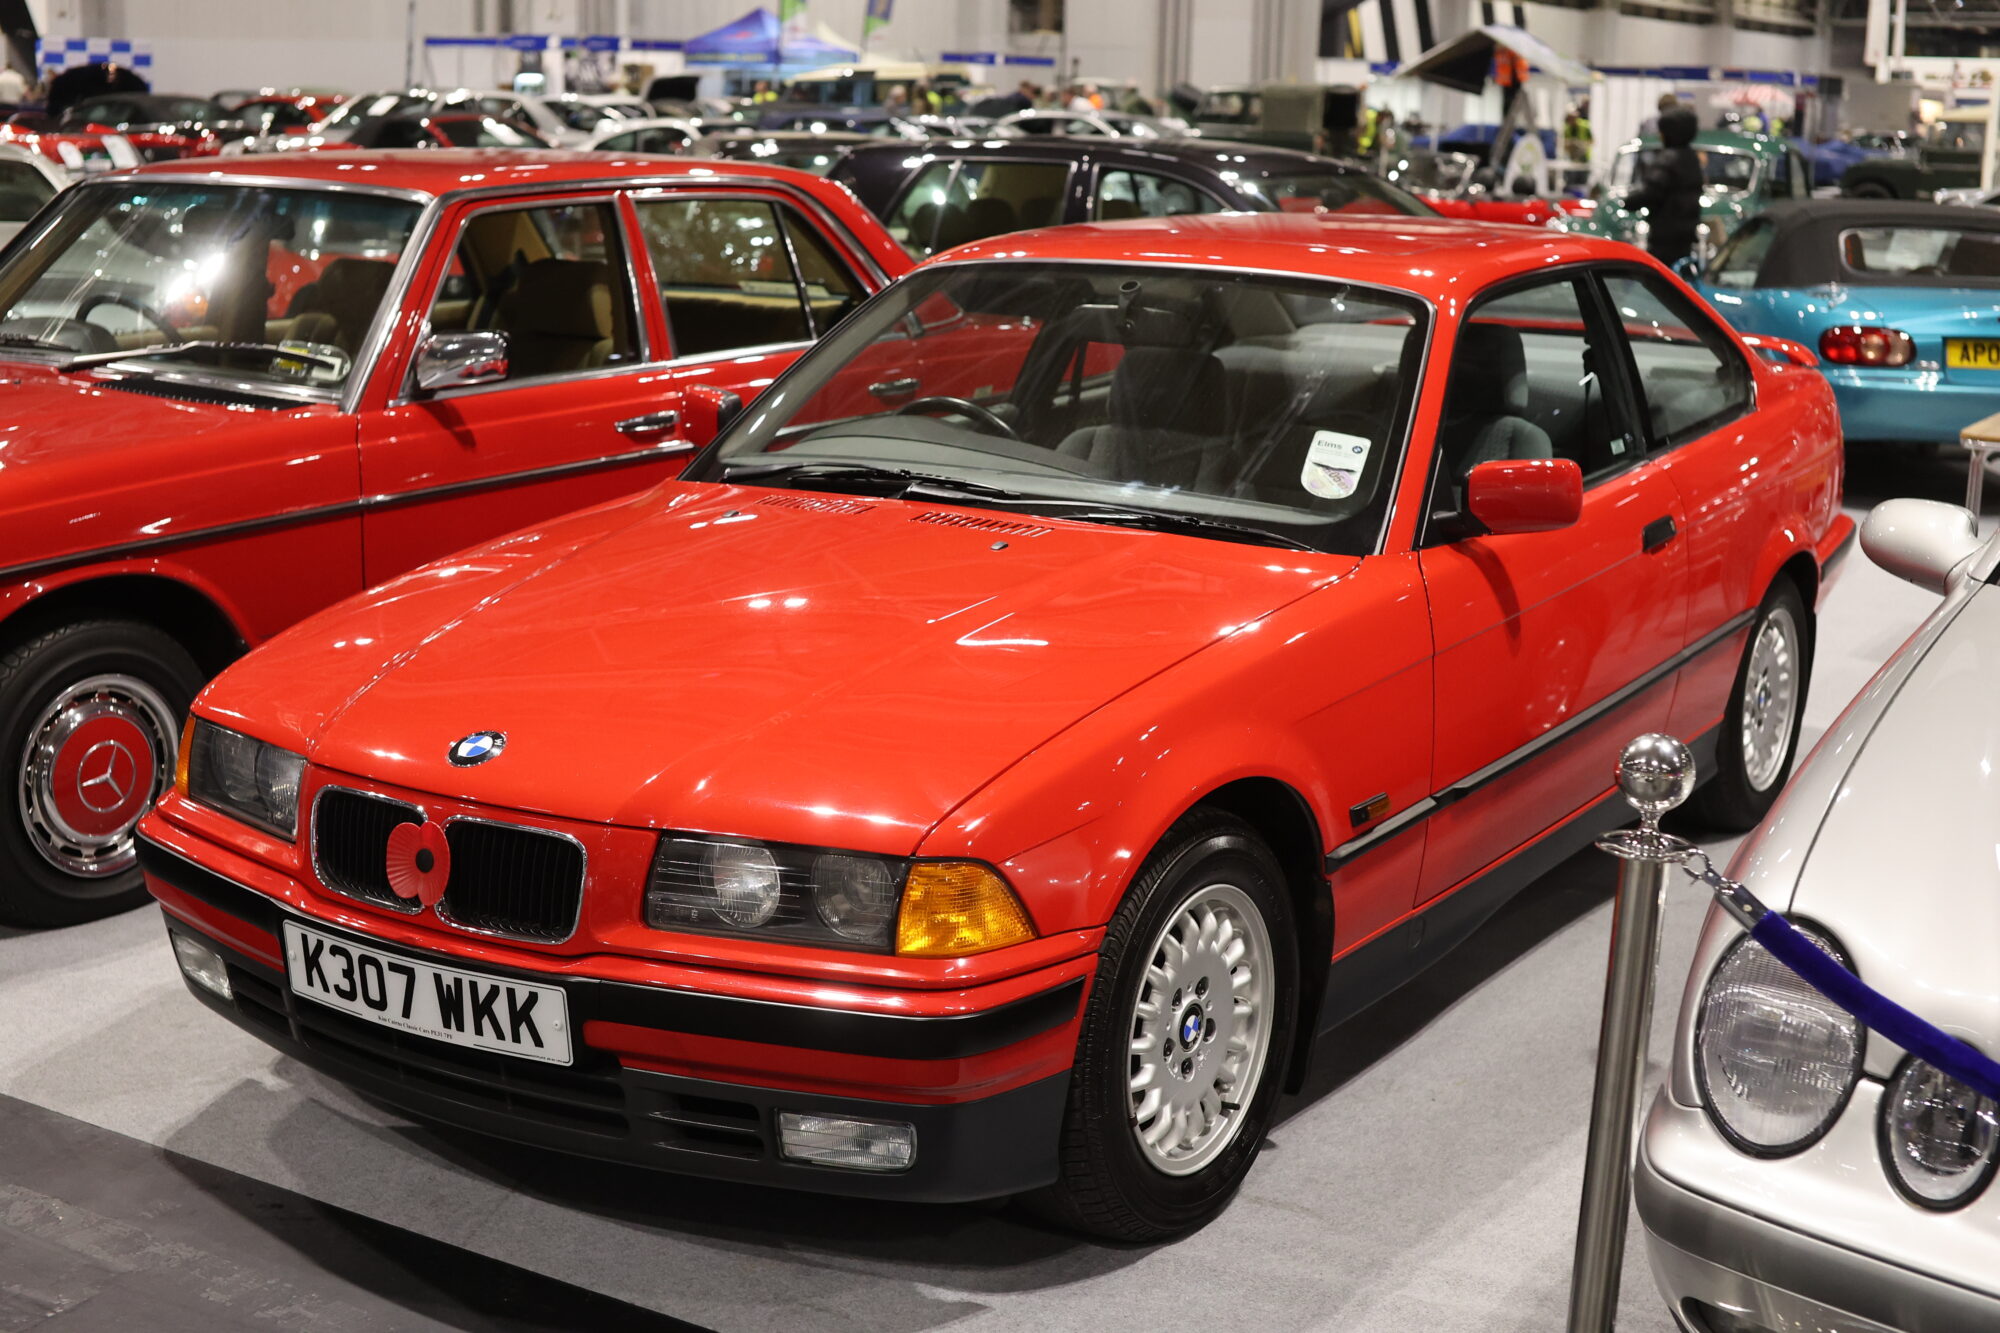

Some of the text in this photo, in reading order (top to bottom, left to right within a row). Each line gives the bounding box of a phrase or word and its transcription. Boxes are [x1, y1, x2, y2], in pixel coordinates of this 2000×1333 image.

[300, 933, 544, 1049] K307 WKK
[403, 1022, 418, 1031] Classic
[419, 1026, 430, 1034] Cars
